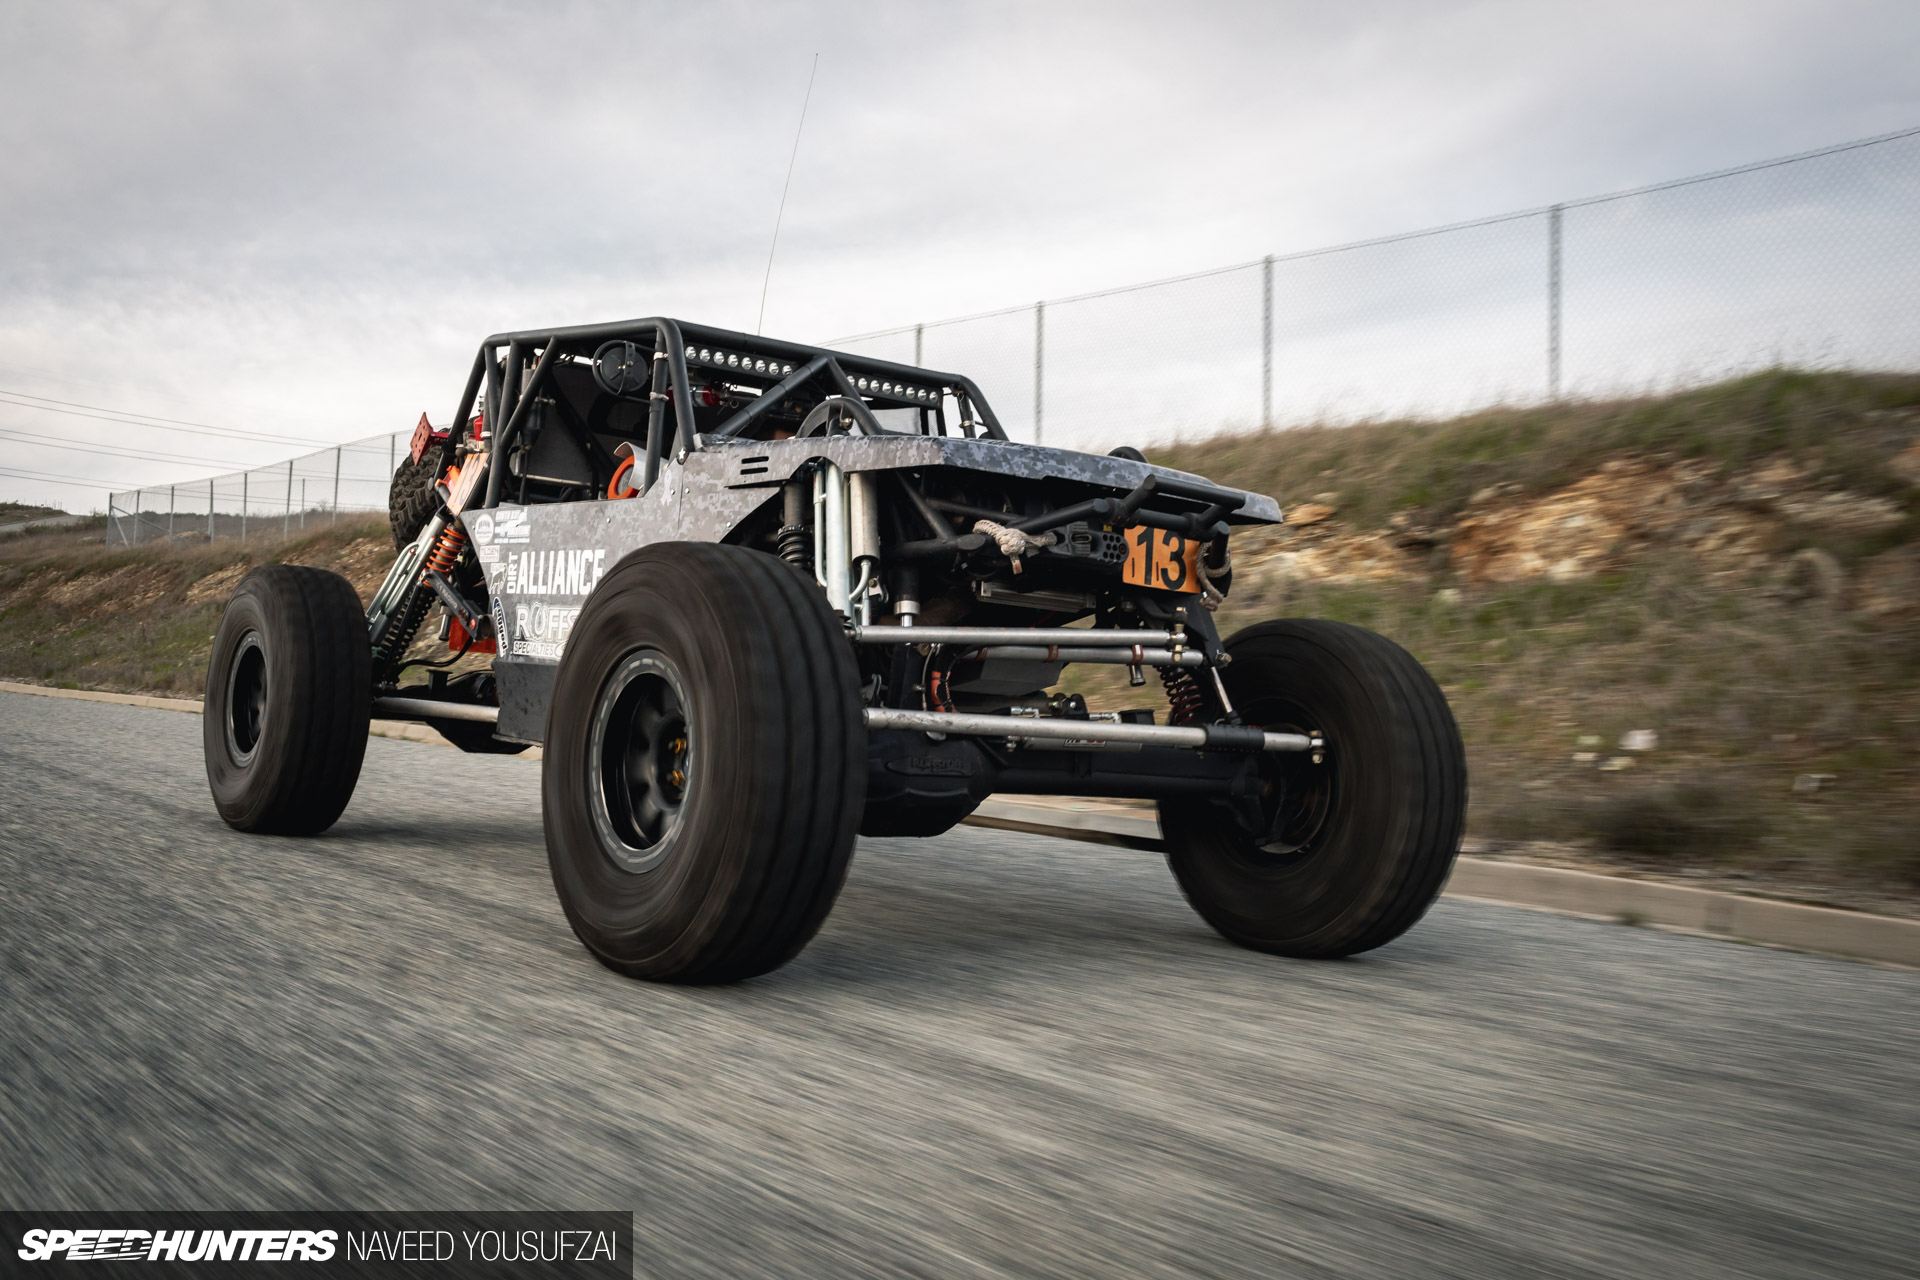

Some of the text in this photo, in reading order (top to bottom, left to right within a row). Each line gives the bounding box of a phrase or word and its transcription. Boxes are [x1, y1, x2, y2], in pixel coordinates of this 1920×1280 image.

[506, 551, 519, 594] DIRT
[515, 549, 605, 595] ALLIANCE
[1137, 526, 1187, 591] 13
[514, 642, 554, 656] SPECIALTIES
